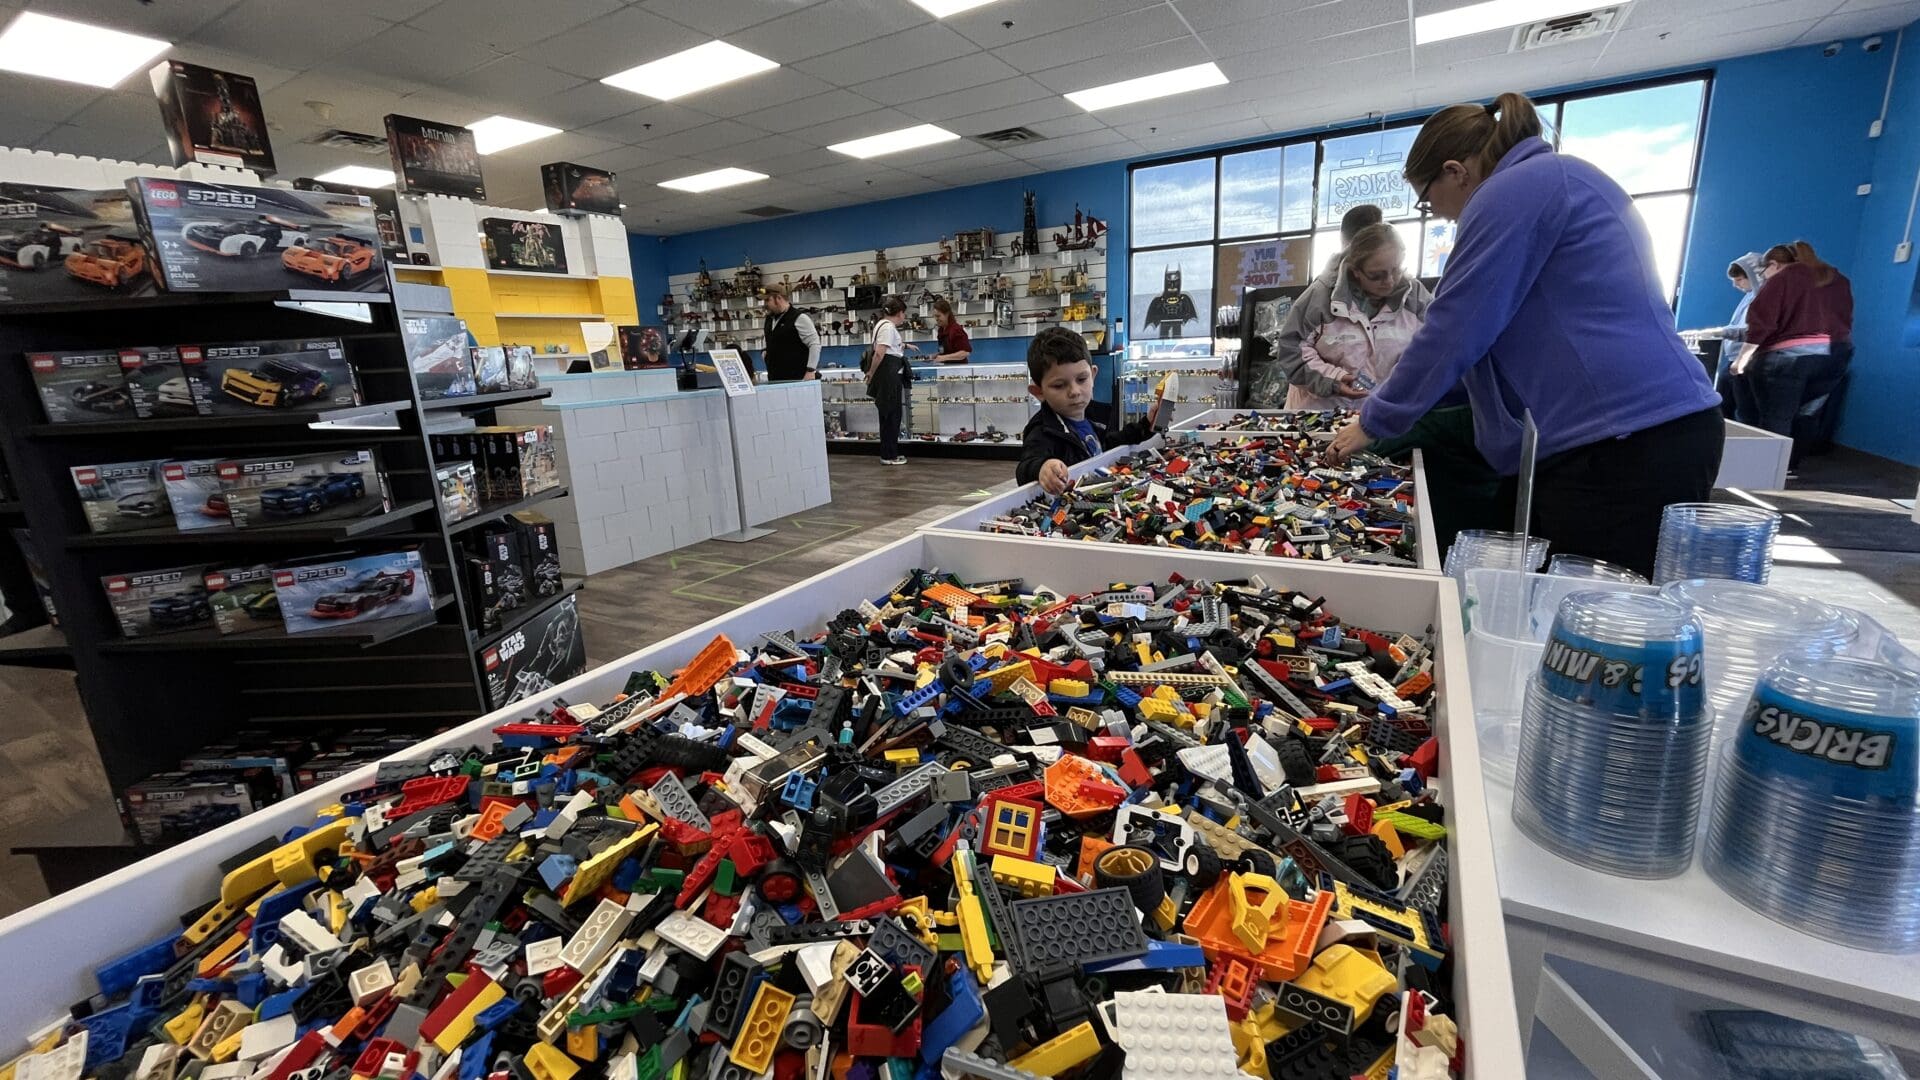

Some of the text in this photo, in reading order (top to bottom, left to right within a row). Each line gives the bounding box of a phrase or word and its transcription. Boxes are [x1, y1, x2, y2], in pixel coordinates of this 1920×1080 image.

[151, 188, 257, 205] LEGO SPEED
[162, 240, 180, 249] 9+
[207, 346, 260, 357] SPEED
[306, 341, 337, 350] NASCAR
[244, 460, 294, 473] SPEED
[131, 572, 182, 586] SPEED
[299, 566, 346, 580] SPEED
[500, 630, 526, 650] STAR
[498, 642, 526, 662] WARS
[1603, 660, 1634, 686] &
[1755, 706, 1893, 768] BRICKS
